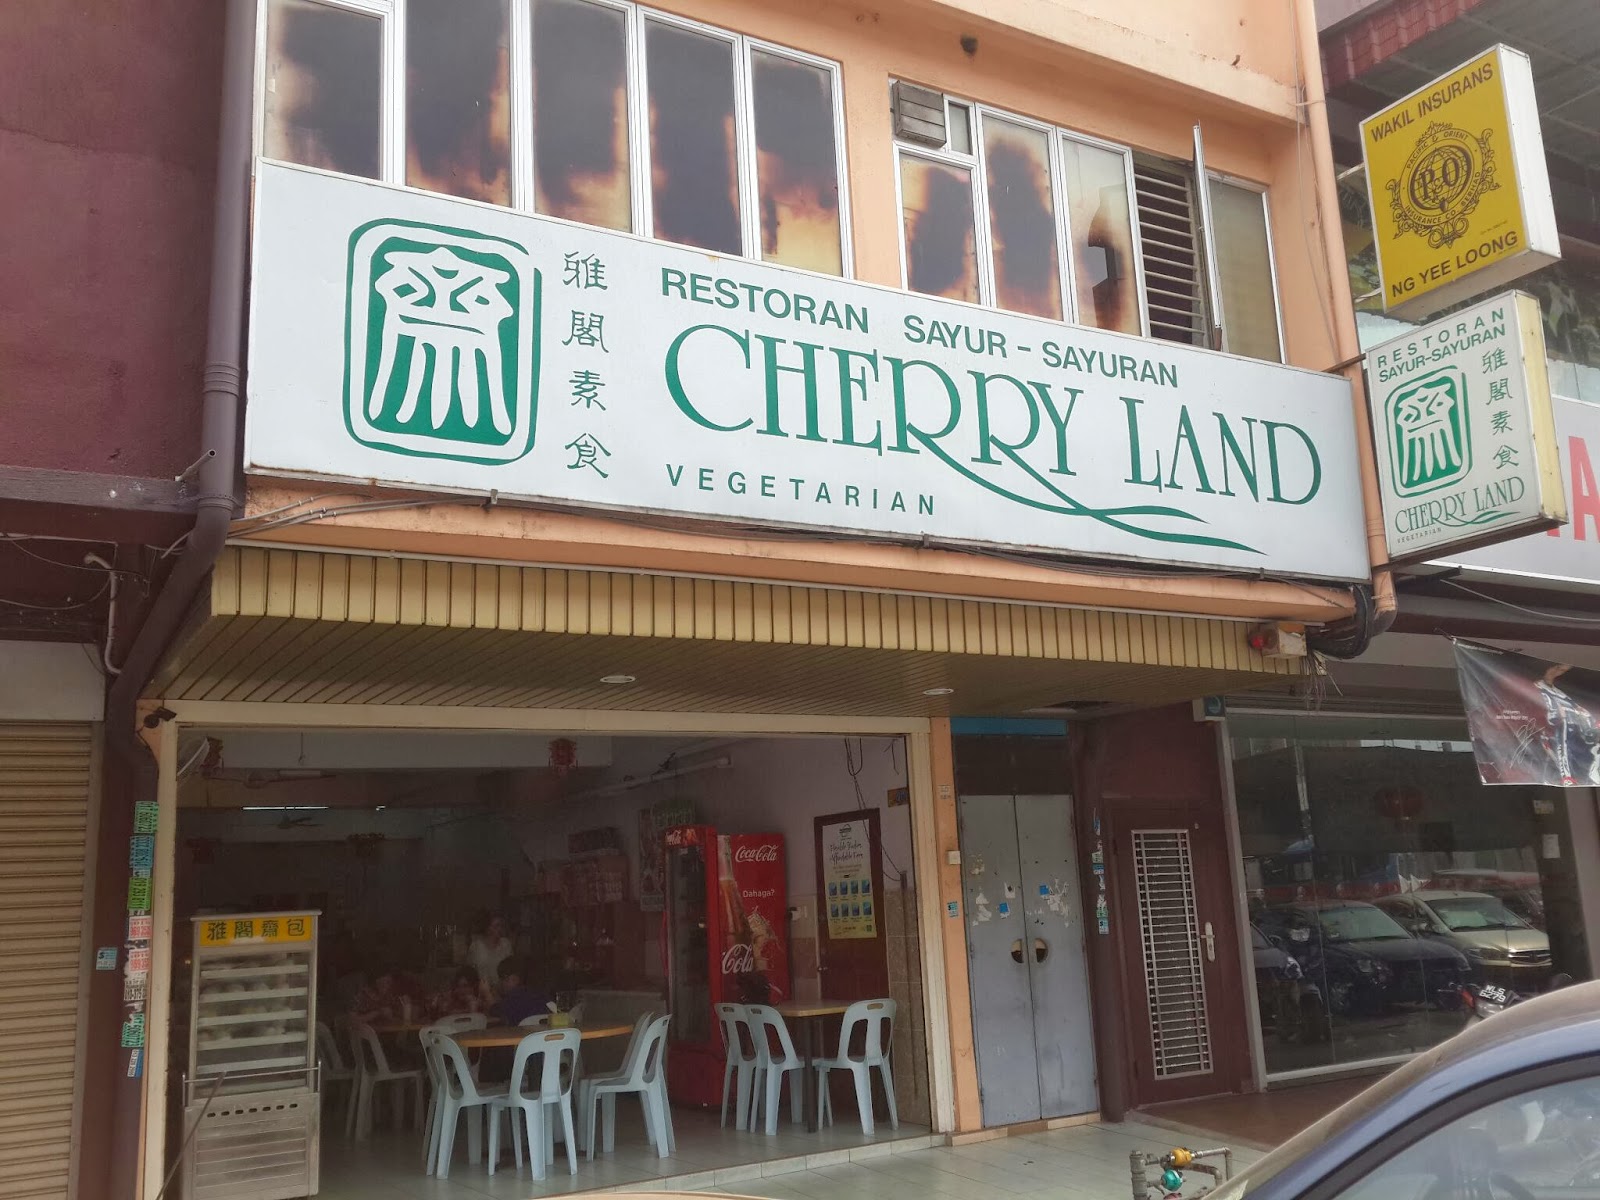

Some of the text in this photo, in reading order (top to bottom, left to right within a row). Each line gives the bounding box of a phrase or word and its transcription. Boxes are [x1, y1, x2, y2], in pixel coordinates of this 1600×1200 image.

[1371, 63, 1494, 143] WAKIL INSURANS
[1406, 141, 1429, 170] PACIFIC
[1443, 130, 1469, 141] ORIENT
[1404, 204, 1442, 225] INSURANCE
[1460, 171, 1482, 207] BERHAD
[1391, 276, 1416, 298] NG
[1418, 259, 1453, 287] YEE
[1456, 230, 1519, 269] LOONG
[661, 267, 869, 334] RESTORAN
[903, 314, 1008, 359] SAYUR
[1042, 341, 1179, 388] SAYURAN
[1377, 307, 1505, 369] RESTORAN
[1379, 323, 1506, 383] SAYUR-SAYURAN
[562, 251, 611, 479] 雅閣素食
[665, 324, 1322, 520] CHERRY LAND
[1482, 347, 1520, 470] 雅閣素食
[666, 463, 934, 516] VEGETARIAN
[1395, 476, 1525, 535] CHERRY LAND
[1397, 527, 1443, 544] VEGETARIAN
[742, 888, 775, 899] Dahaga?
